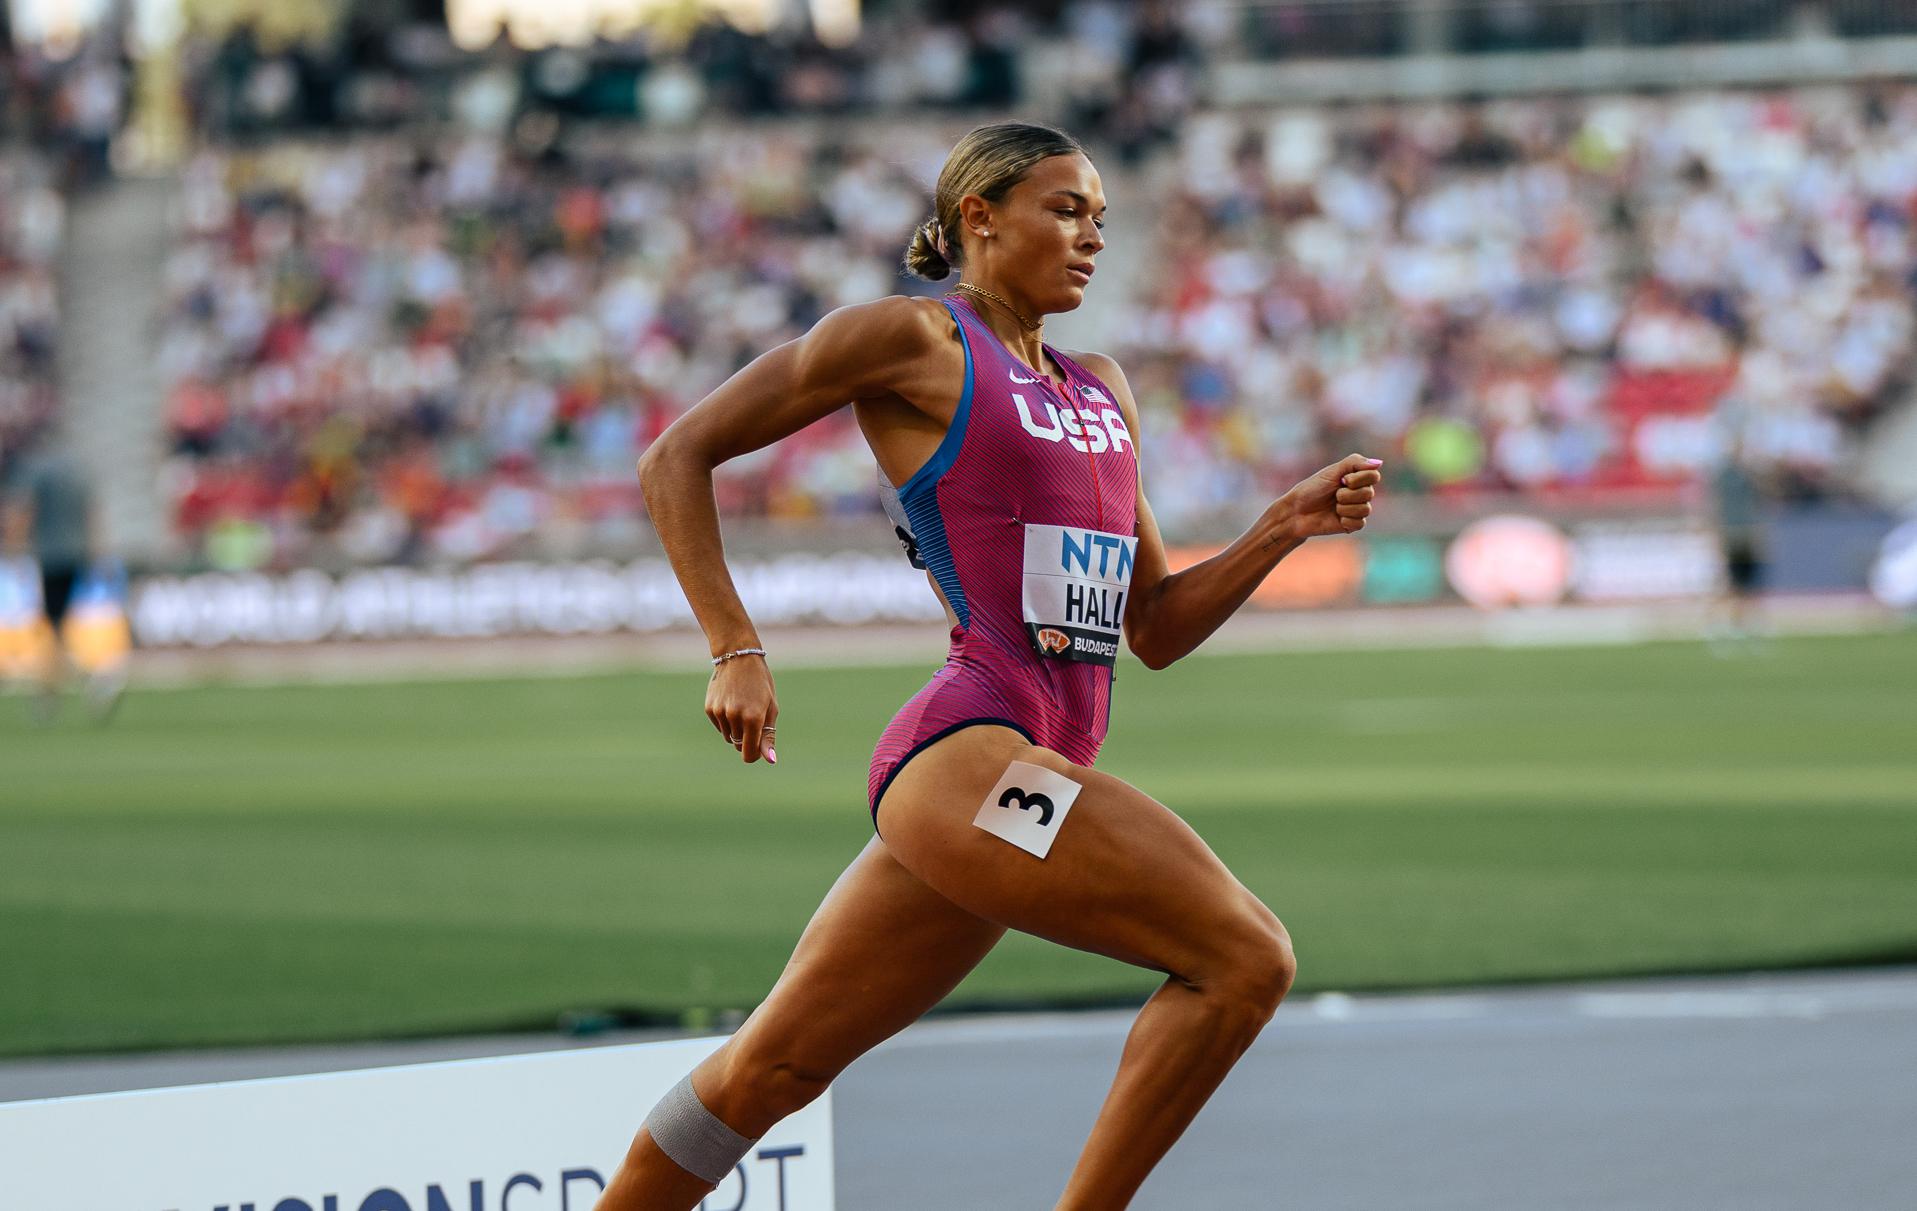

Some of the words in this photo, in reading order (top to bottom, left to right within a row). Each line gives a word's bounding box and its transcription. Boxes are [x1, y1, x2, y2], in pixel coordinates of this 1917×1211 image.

[1012, 393, 1136, 459] USA
[1066, 583, 1124, 630] HALL
[1074, 636, 1118, 657] BUDAPES
[998, 786, 1054, 826] 3
